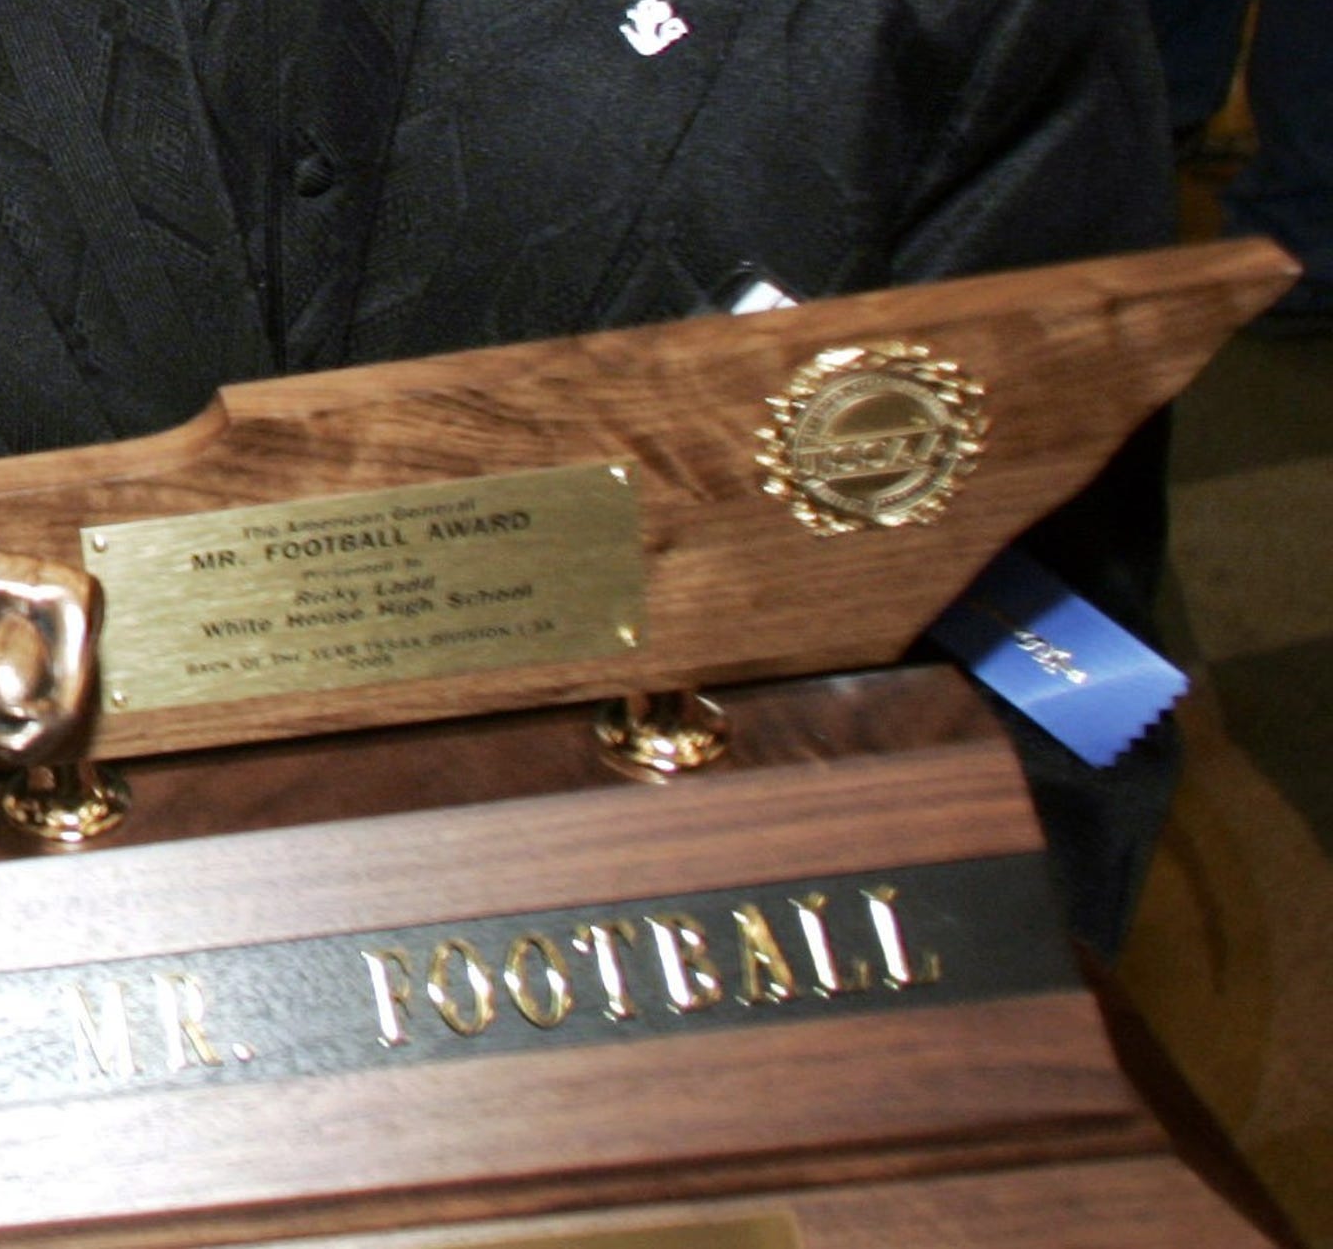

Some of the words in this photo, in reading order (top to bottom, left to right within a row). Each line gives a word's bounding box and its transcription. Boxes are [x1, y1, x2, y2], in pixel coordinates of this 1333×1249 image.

[190, 548, 247, 571] MR.
[264, 529, 410, 563] FOOTBALL
[429, 509, 532, 543] AWARD
[200, 616, 274, 639] White
[285, 607, 365, 630] House
[376, 594, 435, 618] High
[444, 582, 533, 610] School
[62, 968, 255, 1080] MR.
[359, 883, 942, 1051] FOOTBALL
